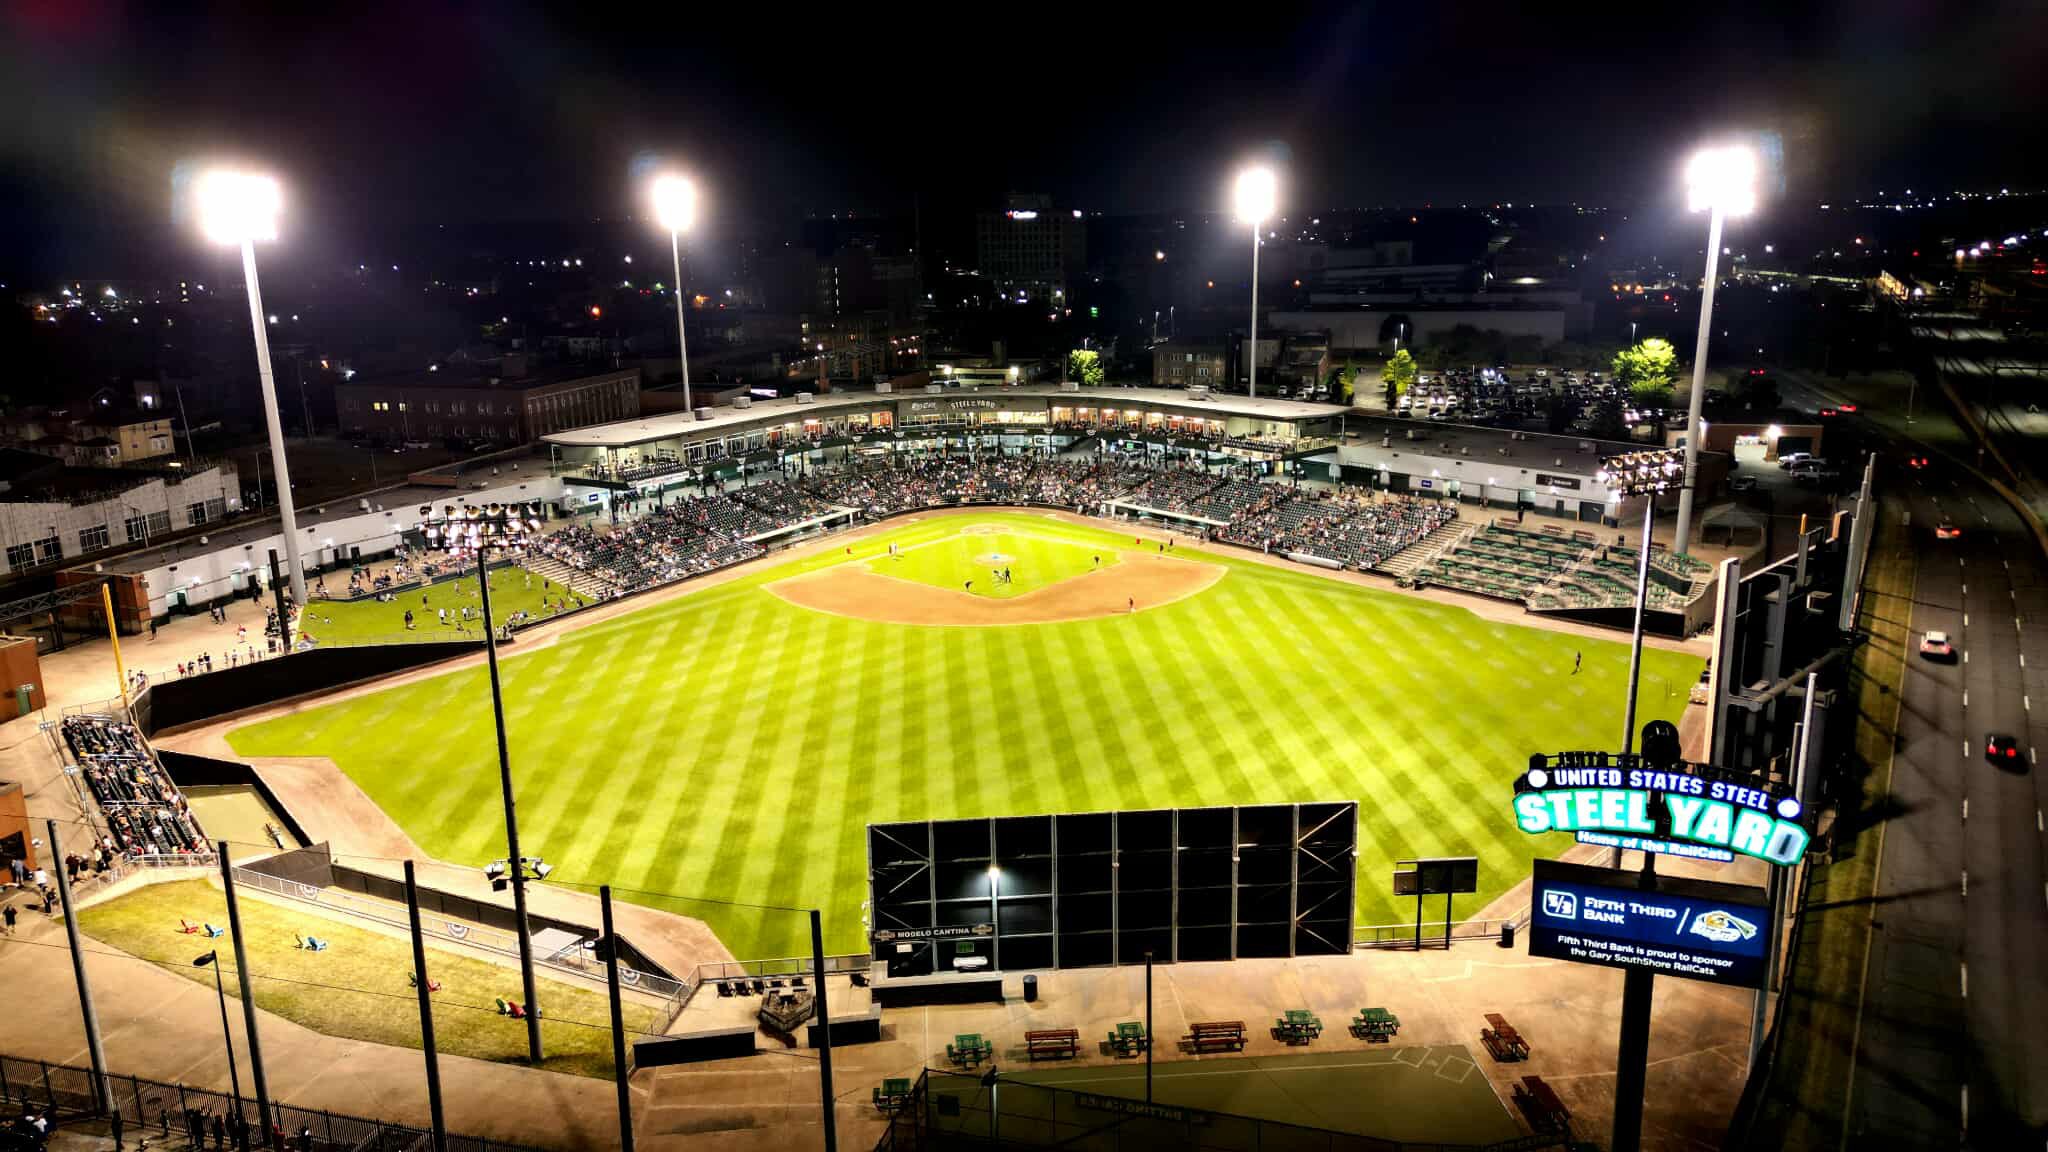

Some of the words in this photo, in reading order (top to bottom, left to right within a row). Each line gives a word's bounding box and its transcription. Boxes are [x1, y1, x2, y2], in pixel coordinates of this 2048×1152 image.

[1554, 769, 1622, 786] UNITED
[1629, 770, 1704, 794] STATES
[1711, 782, 1768, 810] STEEL
[1515, 788, 1654, 833] STEEL
[1666, 794, 1809, 864] YARD
[1578, 831, 1619, 847] Home
[1622, 838, 1637, 848] of
[1641, 839, 1665, 852] the
[1669, 844, 1732, 860] RailCats
[898, 930, 932, 938] MODELO
[933, 928, 970, 936] CANTINA
[1558, 935, 1581, 946] Fifth
[1582, 939, 1607, 949] Third
[1609, 943, 1634, 953] Bank
[1636, 946, 1644, 955] is
[1646, 949, 1677, 960] proud
[1679, 953, 1690, 961] to
[1692, 955, 1734, 967] sponsor
[1570, 947, 1587, 957] the
[1589, 950, 1612, 961] Gary
[1614, 953, 1671, 969] SouthShore
[1673, 962, 1717, 976] RailCats.
